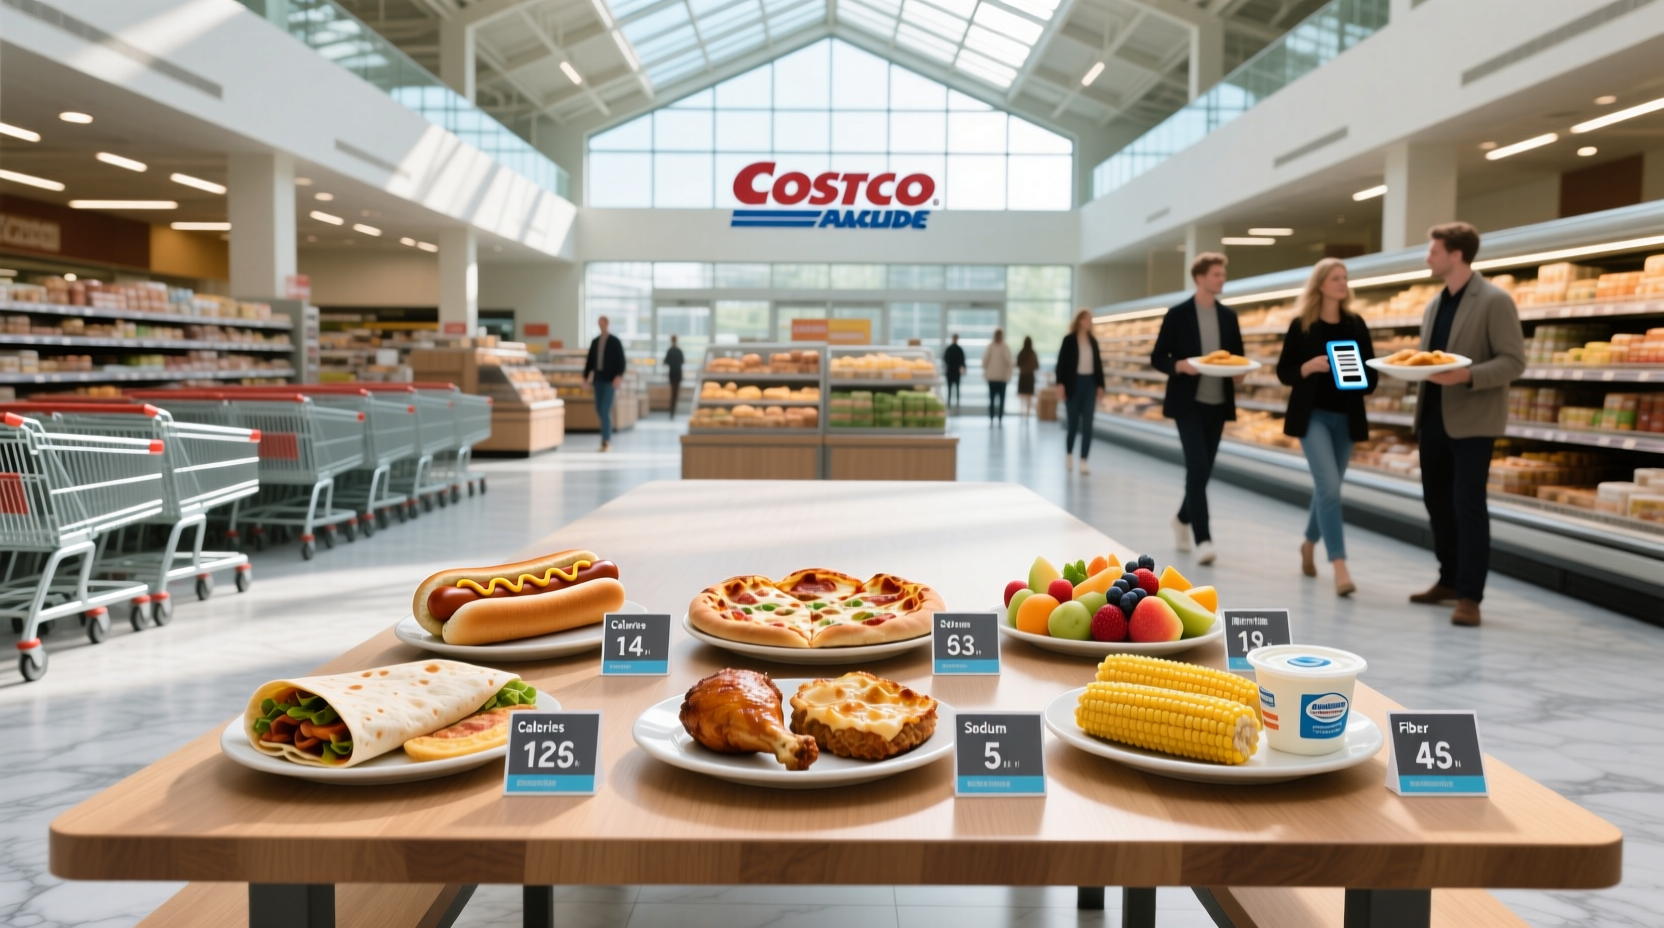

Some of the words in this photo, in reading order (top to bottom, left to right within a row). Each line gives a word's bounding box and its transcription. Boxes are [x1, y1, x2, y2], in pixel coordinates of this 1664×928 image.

[733, 161, 936, 206] COSTCO
[617, 635, 644, 657] 14
[984, 741, 1002, 770] 5
